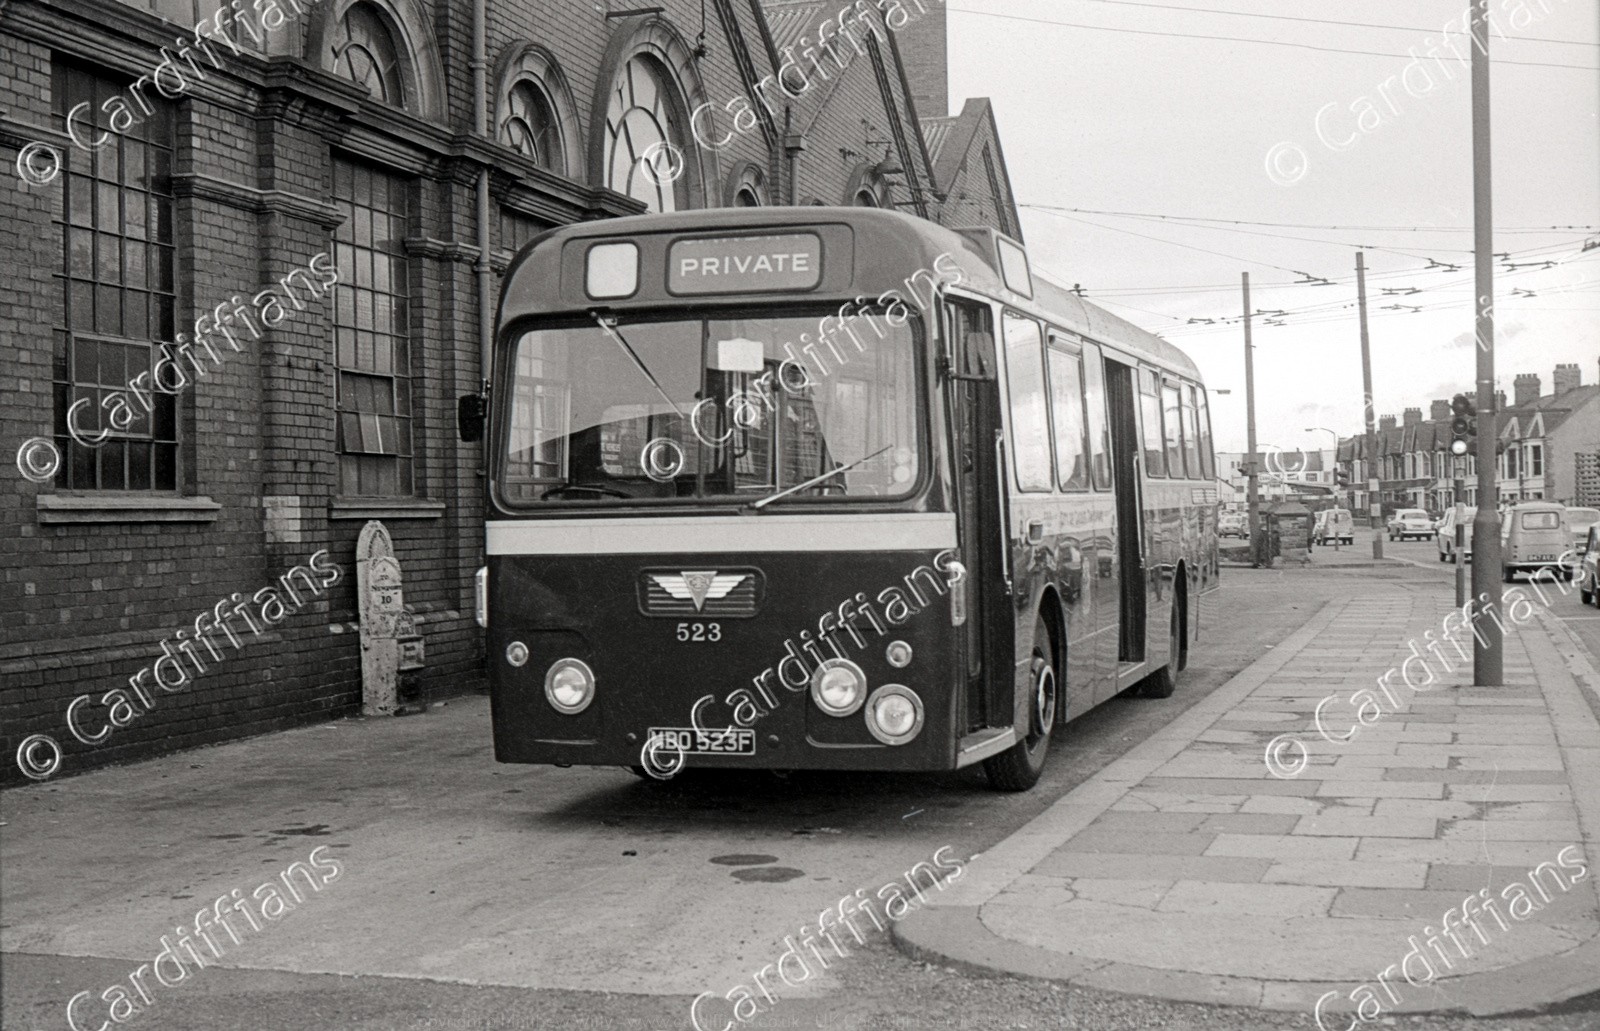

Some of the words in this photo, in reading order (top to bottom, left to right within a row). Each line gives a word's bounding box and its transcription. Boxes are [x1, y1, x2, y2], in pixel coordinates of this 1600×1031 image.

[680, 252, 810, 277] PRIVATE
[381, 595, 392, 604] 10
[676, 623, 721, 642] 523
[696, 731, 752, 752] 523F
